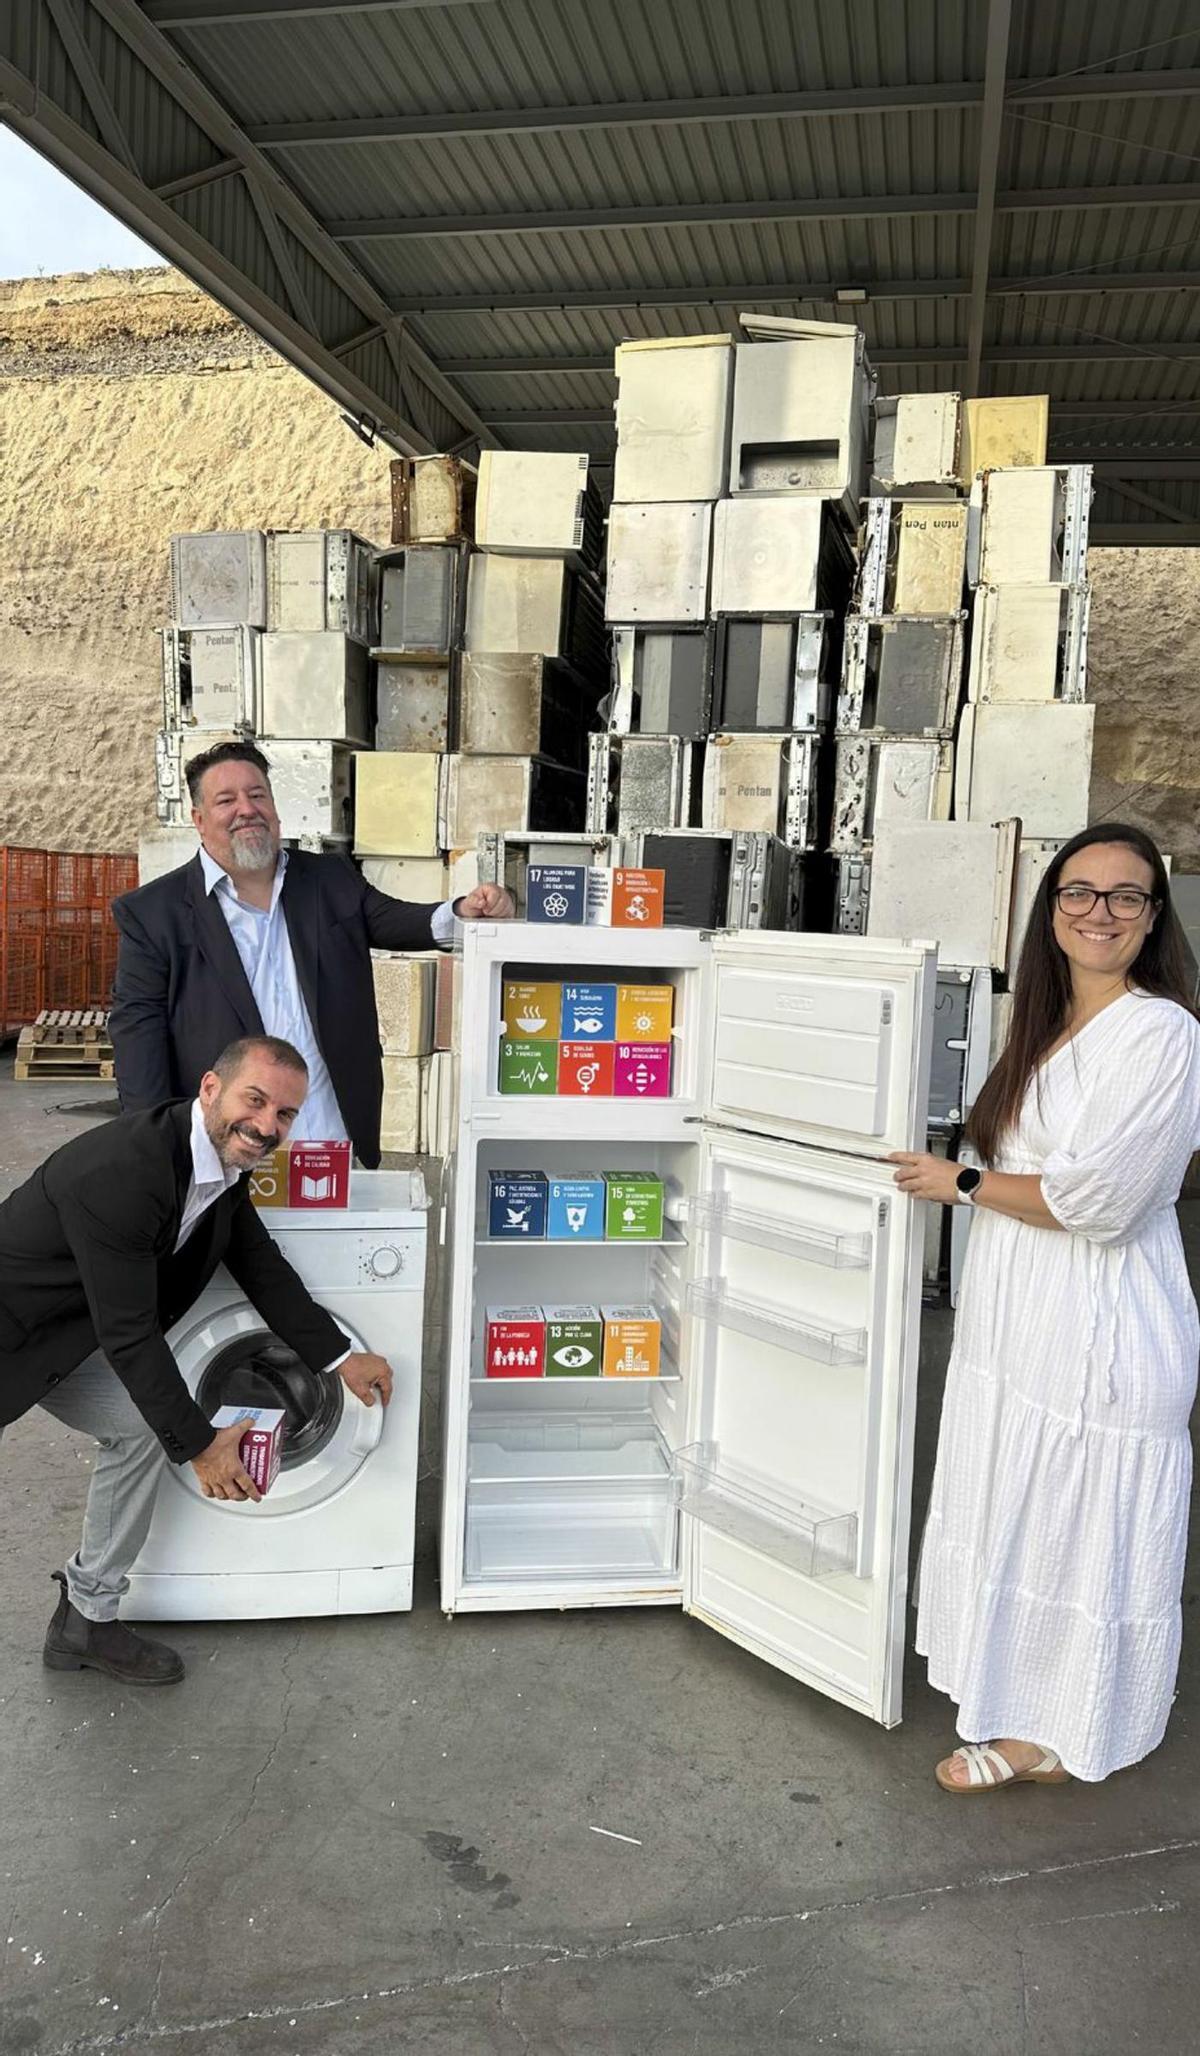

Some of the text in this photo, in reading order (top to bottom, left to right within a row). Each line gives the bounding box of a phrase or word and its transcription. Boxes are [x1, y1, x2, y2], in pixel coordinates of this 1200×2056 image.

[737, 784, 772, 796] Pentan
[530, 869, 541, 882] 17
[616, 872, 624, 886] 9
[508, 986, 516, 999] 2
[566, 988, 578, 1000] 14
[621, 989, 628, 1002] 7
[505, 1044, 513, 1056] 3
[562, 1045, 570, 1058] 5
[619, 1046, 630, 1059] 10
[294, 1155, 302, 1167] 4
[495, 1185, 506, 1197] 16
[553, 1186, 560, 1198] 6
[611, 1187, 623, 1199] 15
[492, 1326, 498, 1338] 1
[550, 1326, 561, 1338] 13
[610, 1325, 619, 1337] 11
[252, 1434, 267, 1442] 8
